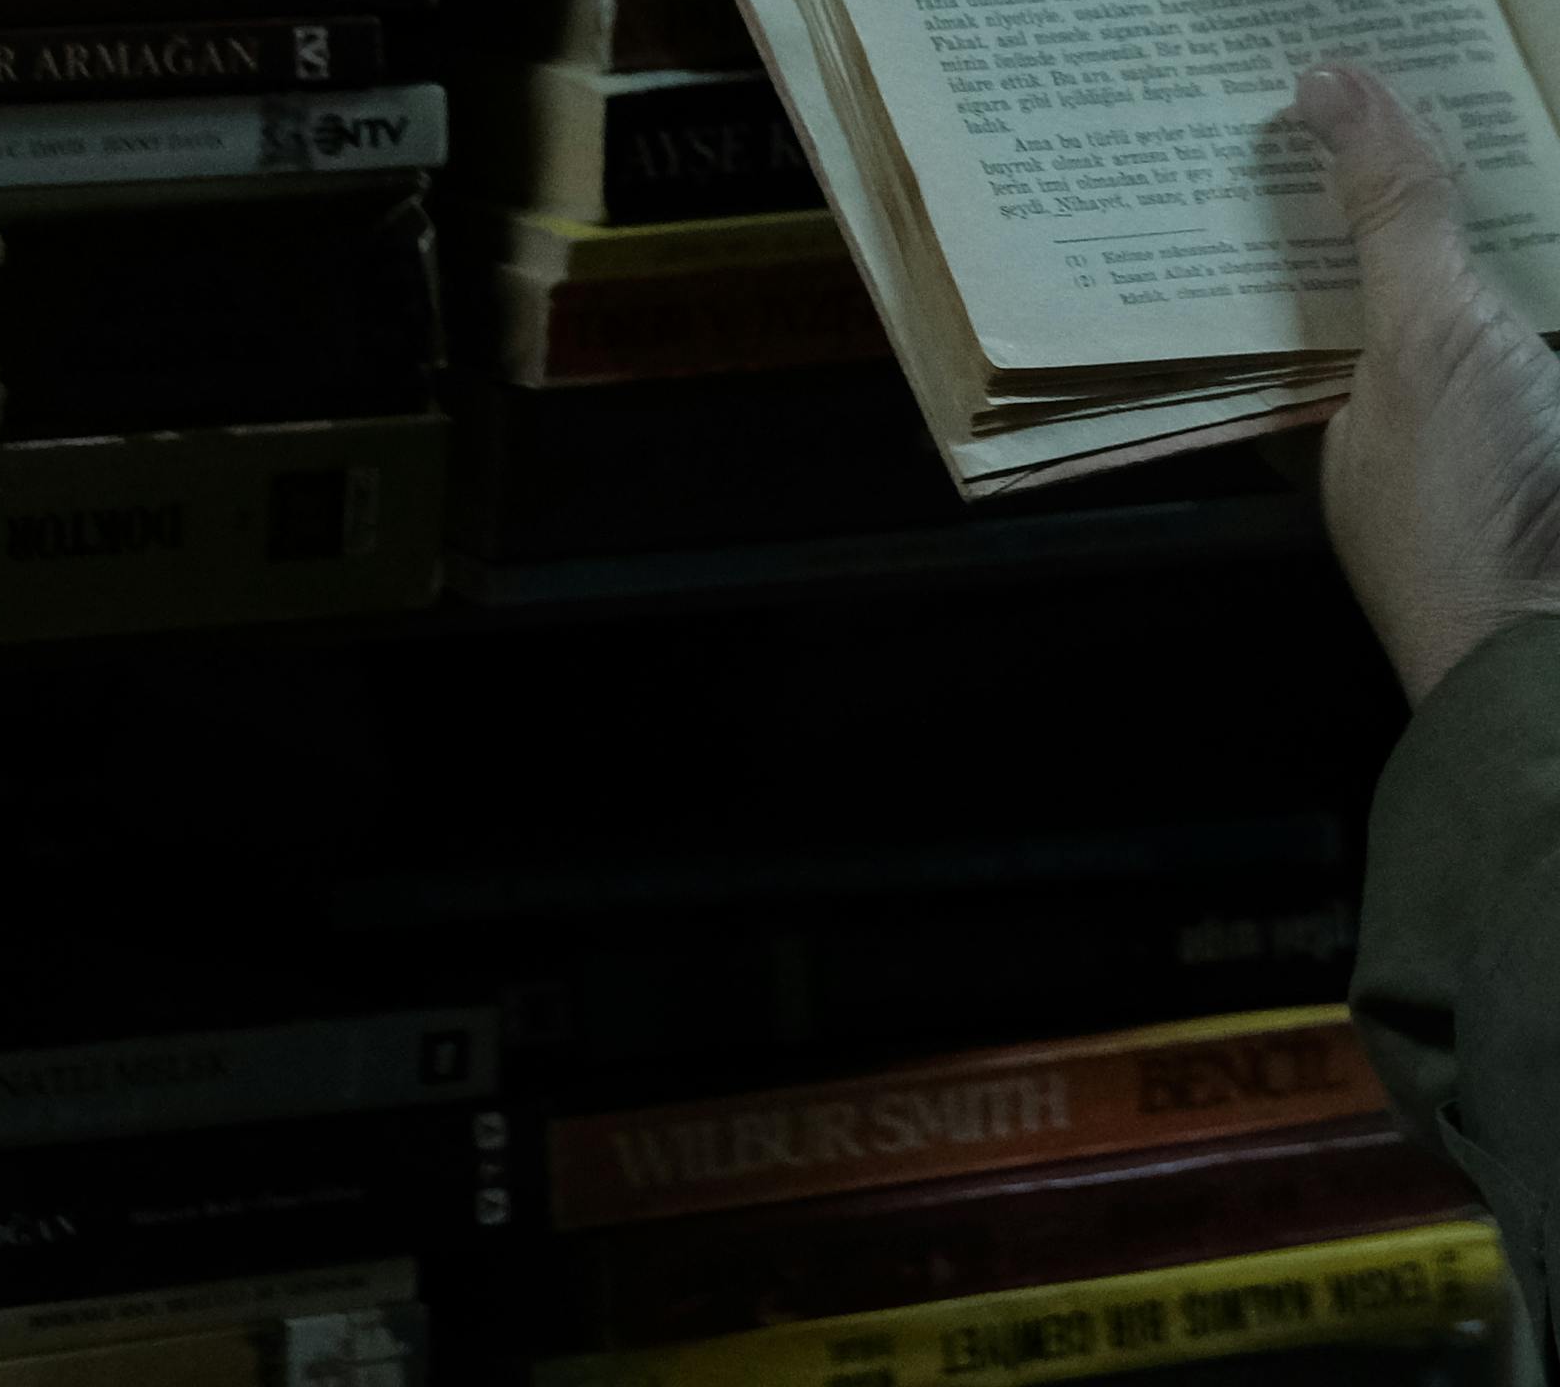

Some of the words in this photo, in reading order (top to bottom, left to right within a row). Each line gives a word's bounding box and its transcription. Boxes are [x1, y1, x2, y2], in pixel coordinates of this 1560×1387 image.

[33, 29, 262, 83] ARMAĞAN
[342, 115, 408, 150] NTV
[607, 1098, 867, 1189] WILBUR
[872, 1072, 1071, 1152] SMITH
